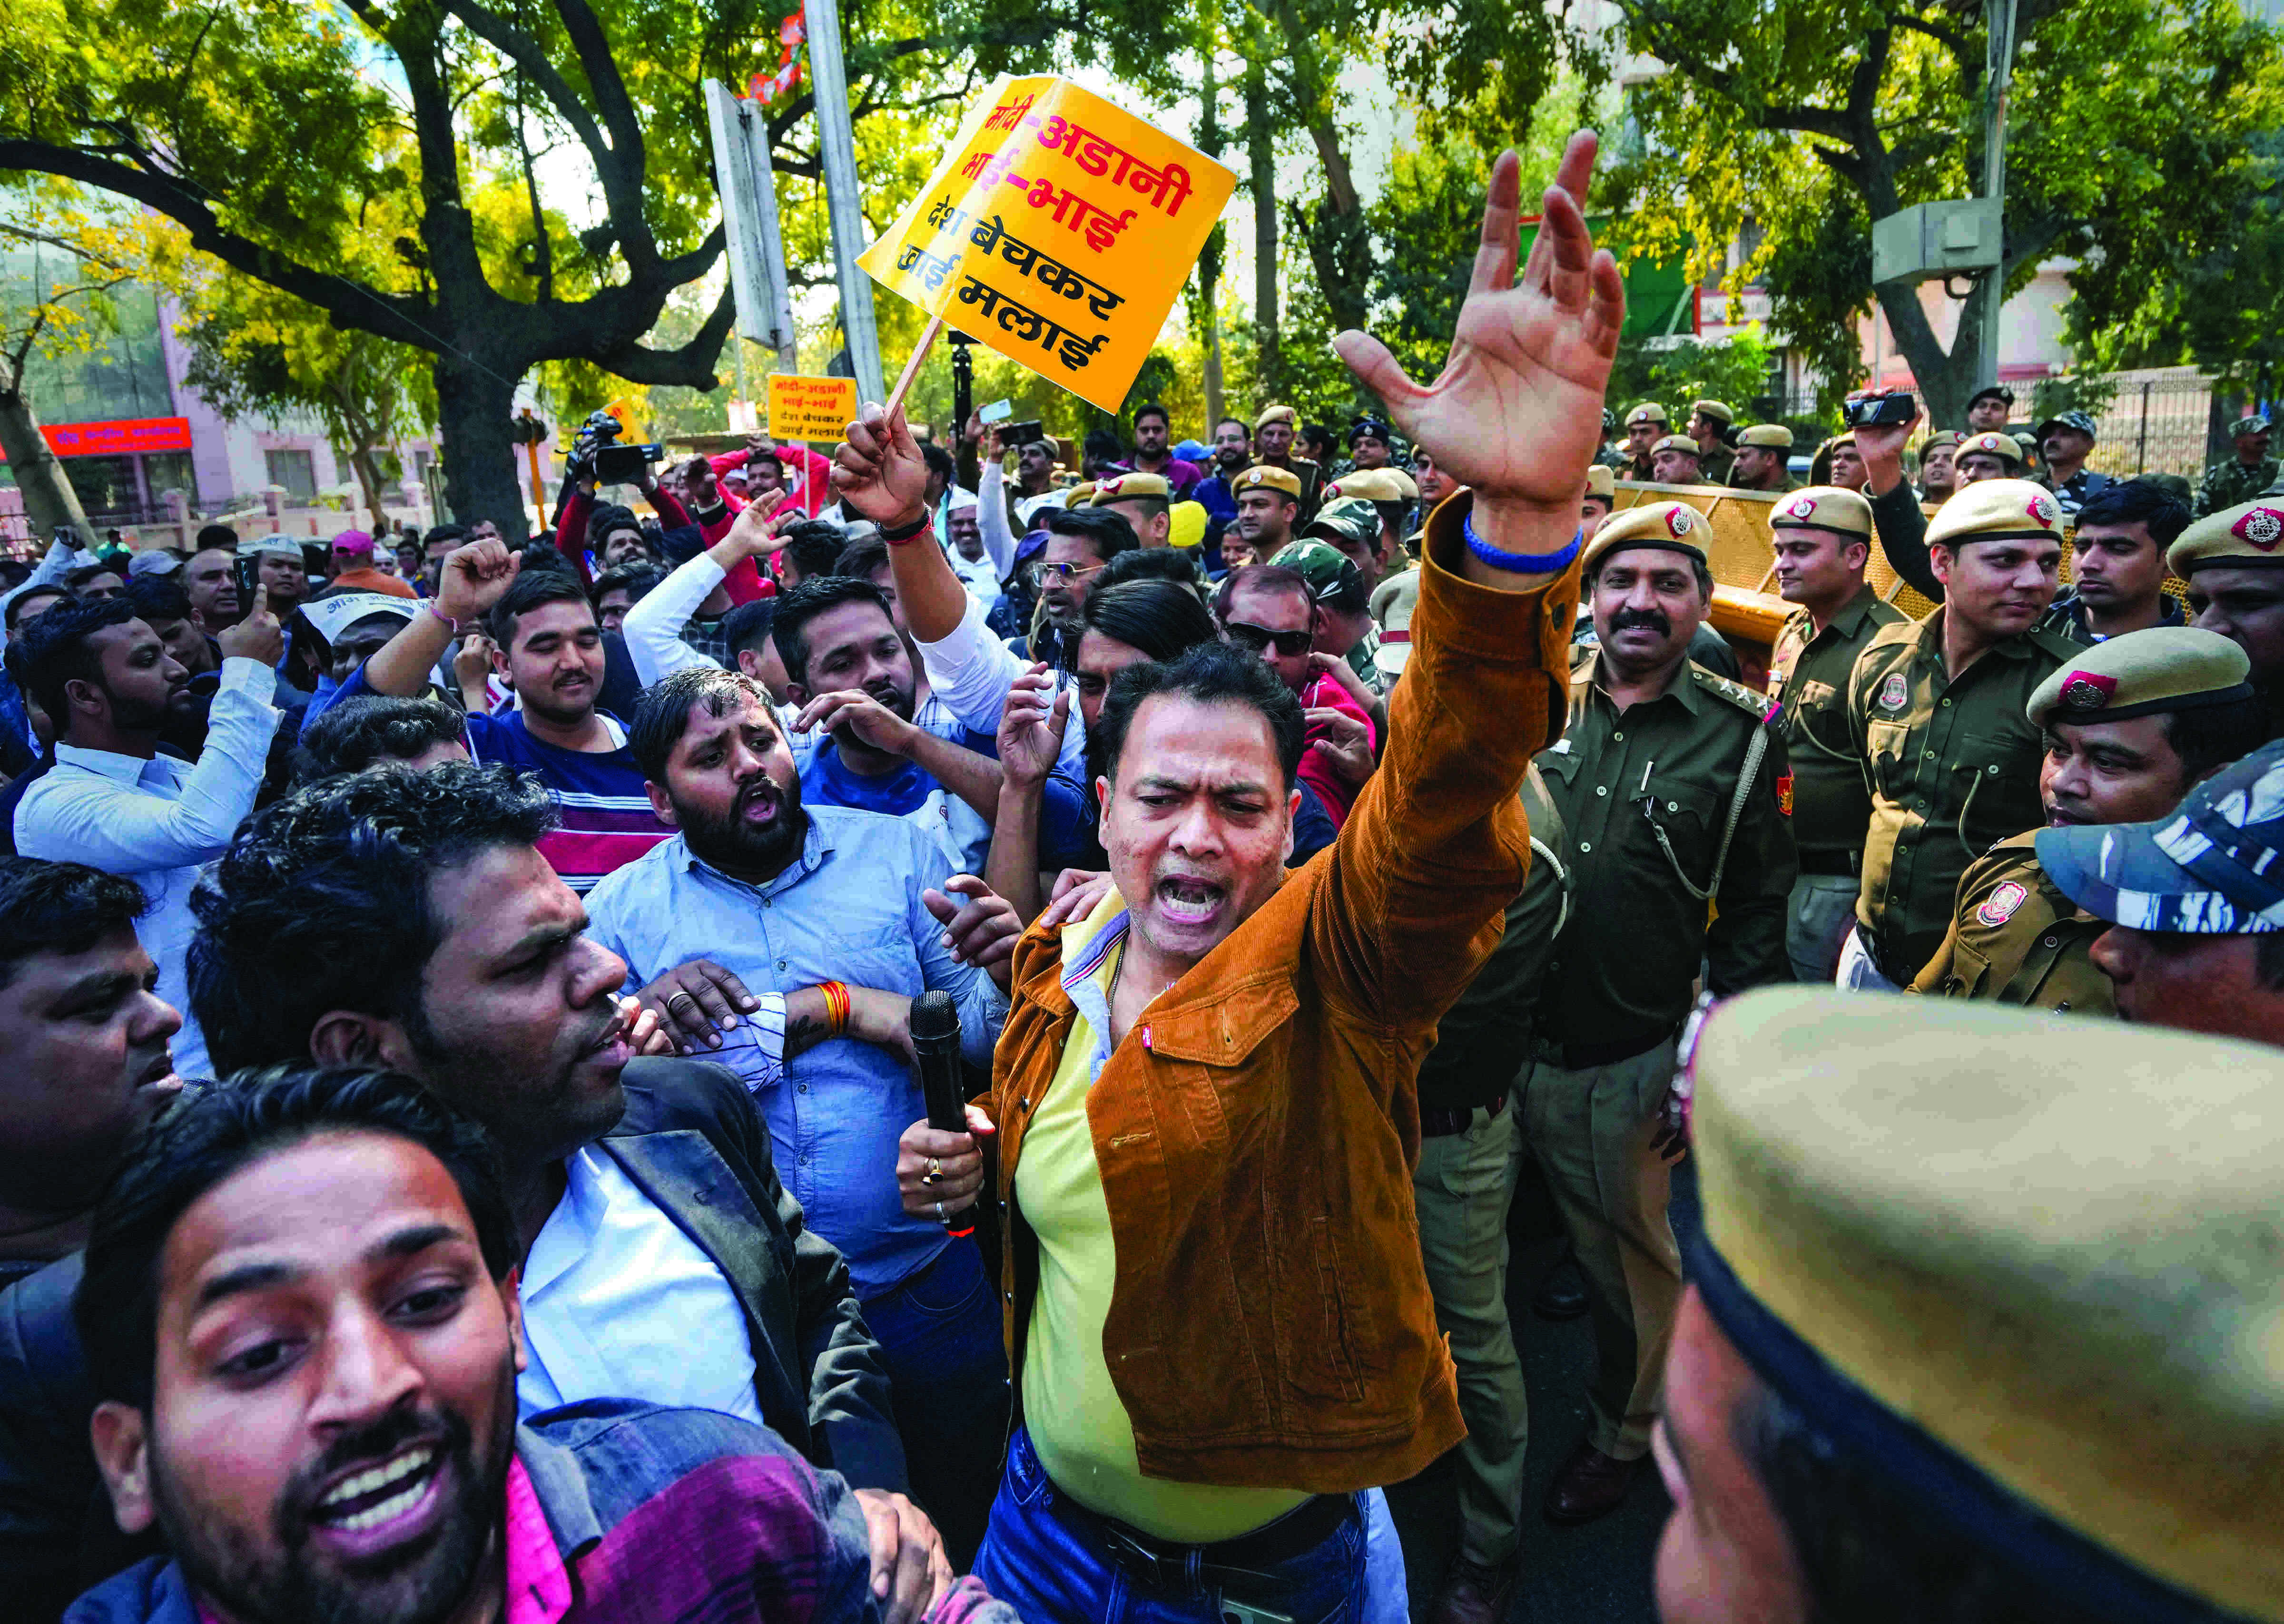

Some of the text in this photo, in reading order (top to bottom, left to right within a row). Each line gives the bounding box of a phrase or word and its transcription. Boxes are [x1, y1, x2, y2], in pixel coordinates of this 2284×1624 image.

[961, 147, 1137, 254] भाई-भाई
[984, 93, 1193, 217] मोदी-अडानी
[897, 243, 1110, 371] खाई मलाई
[927, 194, 1126, 322] देश बेचकर
[803, 412, 844, 423] बेचकर
[808, 427, 845, 438] मलाई
